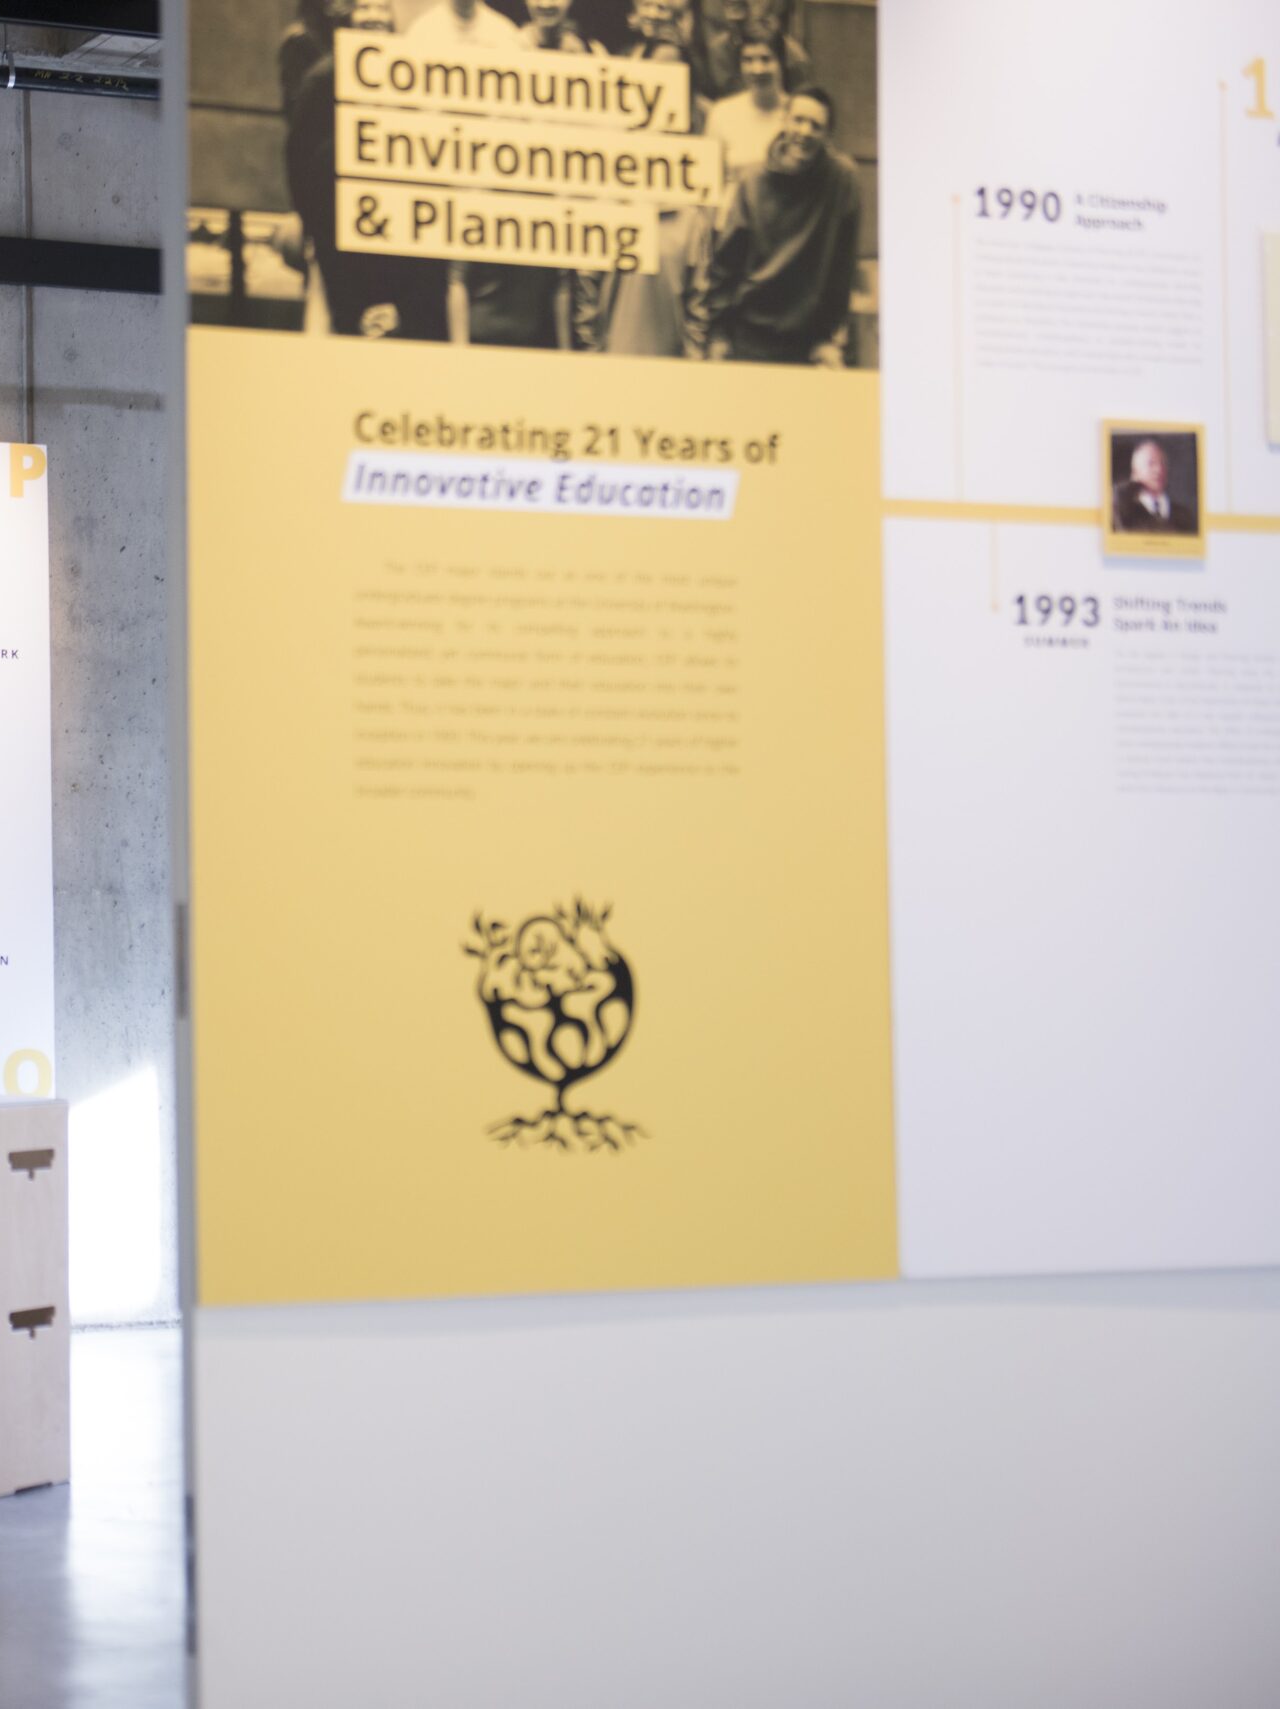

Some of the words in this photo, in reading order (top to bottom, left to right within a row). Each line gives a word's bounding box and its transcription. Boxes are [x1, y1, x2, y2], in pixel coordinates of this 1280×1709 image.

[354, 46, 678, 130] Community,
[357, 121, 712, 200] Environment,
[976, 187, 1062, 223] 1990
[354, 195, 390, 238] &
[412, 200, 641, 273] Planning
[354, 411, 572, 462] Celebrating
[583, 423, 619, 457] 21
[634, 427, 732, 463] Years
[746, 432, 781, 464] of
[353, 461, 543, 504] Innovative
[555, 473, 726, 514] Education
[1015, 594, 1101, 628] 1993
